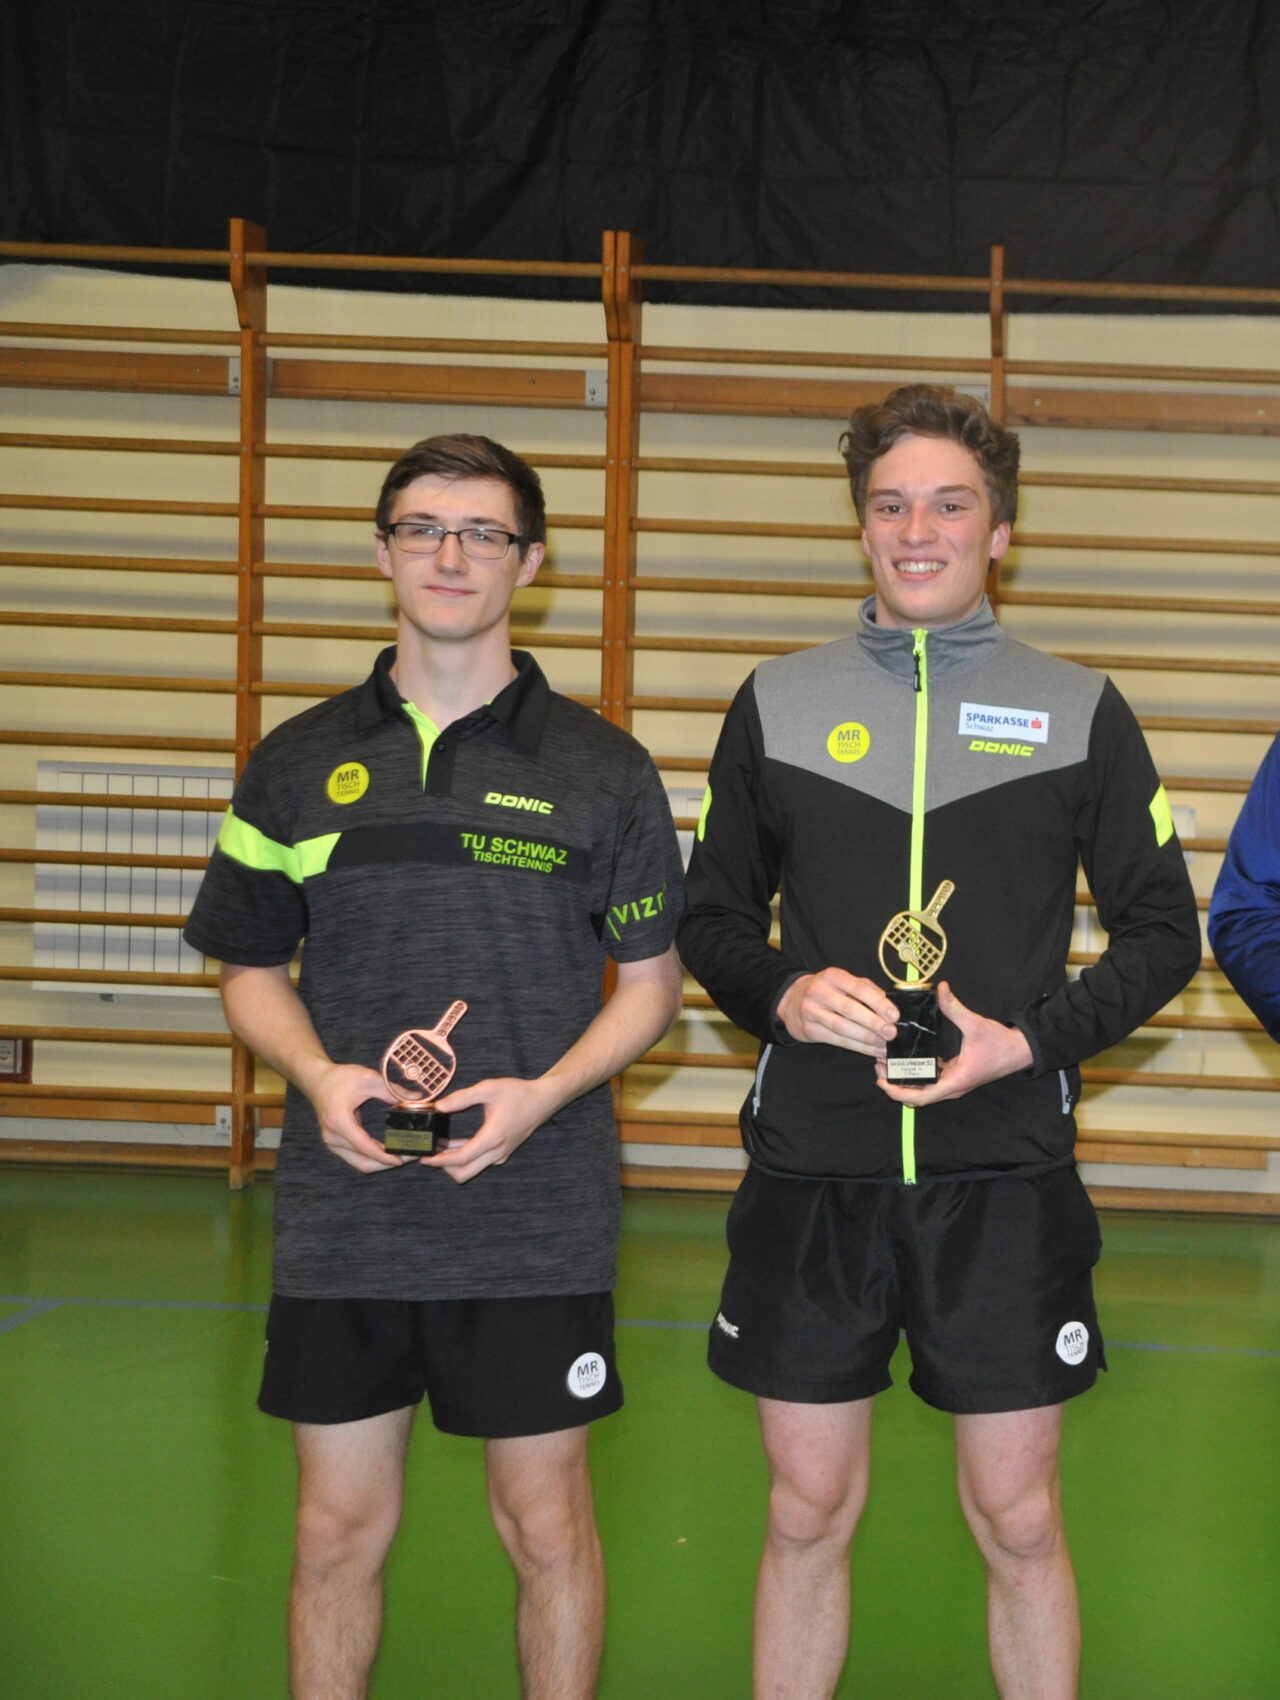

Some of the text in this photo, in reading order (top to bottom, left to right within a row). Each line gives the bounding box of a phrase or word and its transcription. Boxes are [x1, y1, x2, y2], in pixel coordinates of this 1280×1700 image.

[966, 712, 1030, 728] SPARKASSE
[838, 730, 860, 741] MR
[969, 740, 1034, 757] DONIC
[337, 769, 359, 783] MR
[484, 792, 554, 815] DONIC
[460, 833, 568, 865] TU SCHWAZ
[473, 850, 553, 873] TISCHTENNIS
[1063, 1329, 1082, 1346] MR
[577, 1360, 598, 1378] MR
